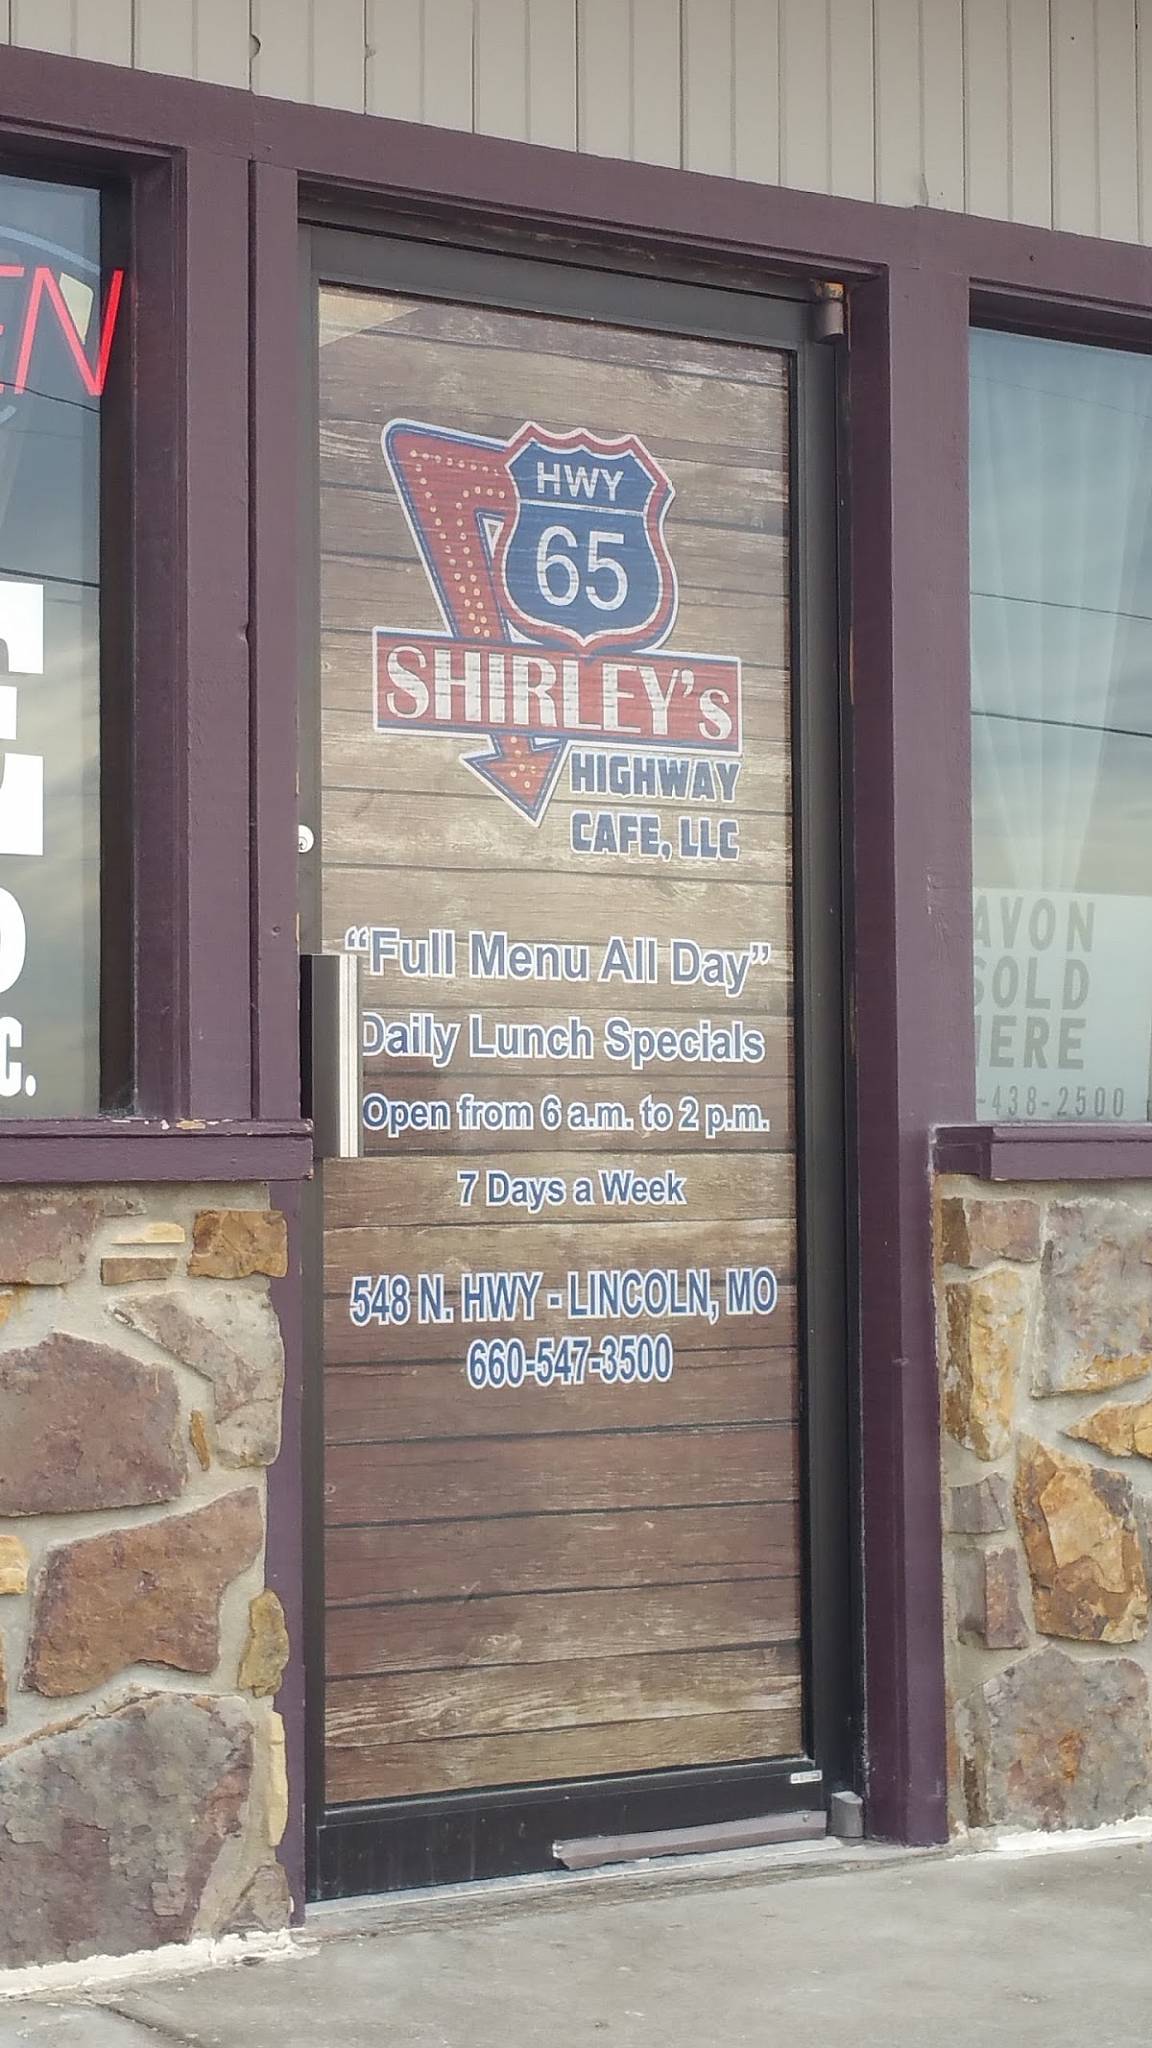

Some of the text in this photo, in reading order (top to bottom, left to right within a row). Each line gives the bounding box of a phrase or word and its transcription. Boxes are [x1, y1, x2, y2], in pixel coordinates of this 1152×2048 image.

[0, 265, 124, 395] N
[536, 461, 623, 500] HWY
[536, 525, 629, 611] 65
[569, 751, 741, 802] HIGHWAY
[569, 809, 740, 861] CAFE, LLC
[973, 895, 1095, 952] AVON
[469, 930, 589, 981] Menu
[601, 936, 658, 984] All
[362, 1011, 767, 1069] Daily Lunch Specials
[362, 1092, 771, 1138] Open from 6 a.m. to 2 p.m.
[456, 1170, 689, 1213] 7 Days a Week
[350, 1275, 411, 1326] 548
[417, 1275, 455, 1325] N.
[461, 1271, 544, 1322] HWY
[567, 1268, 720, 1325] LINCOLN,
[726, 1267, 778, 1316] MO
[467, 1332, 673, 1390] 660-547-3500
